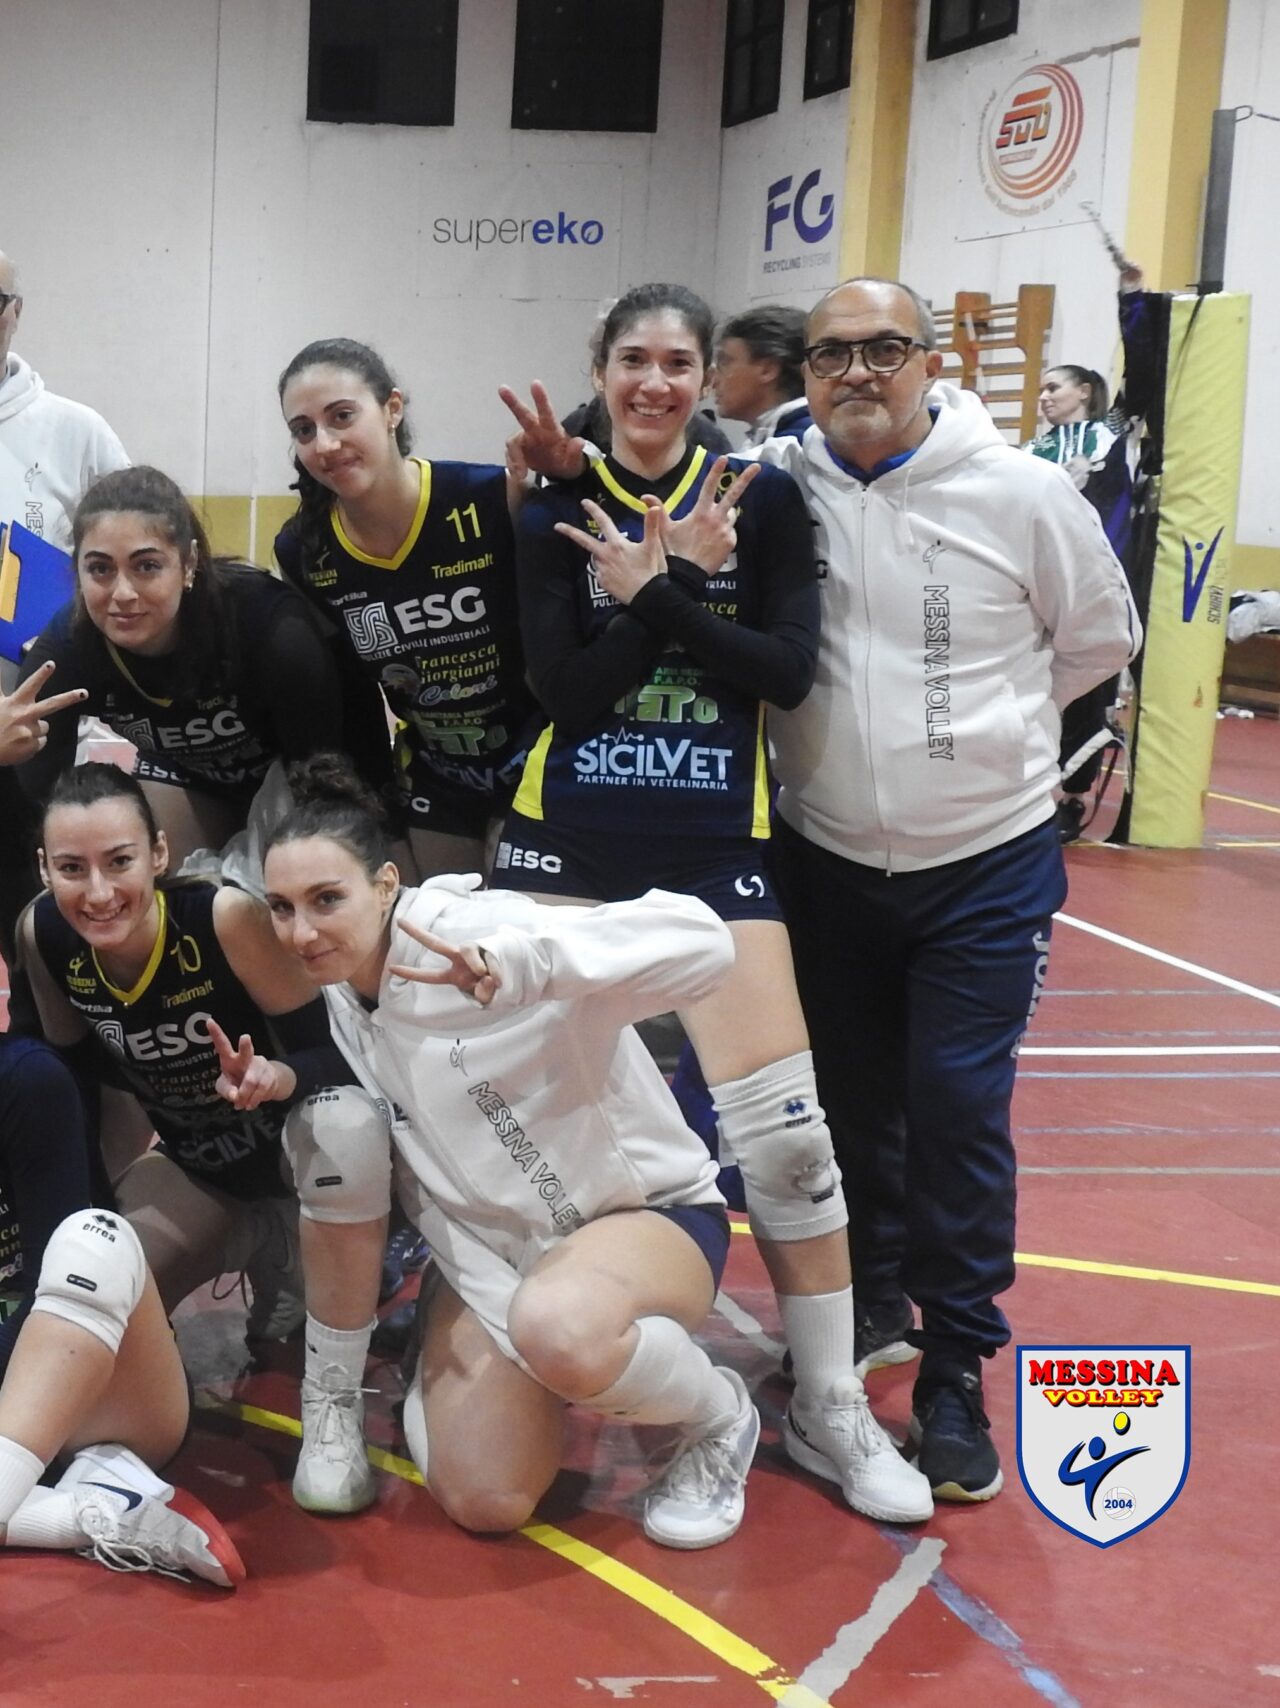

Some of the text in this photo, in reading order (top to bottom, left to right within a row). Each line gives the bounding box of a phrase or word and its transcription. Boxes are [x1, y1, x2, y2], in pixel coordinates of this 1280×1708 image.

[764, 168, 835, 252] FG
[432, 211, 604, 251] supereko
[445, 502, 482, 543] 11
[431, 552, 494, 579] Tradimalt
[393, 586, 487, 634] ESG
[429, 624, 491, 647] INDUSTRIALI
[923, 585, 955, 761] MESSINA VOLLEY
[157, 710, 246, 748] ESG
[574, 738, 732, 780] SICILVET
[577, 774, 729, 791] PARTNER IN VETERINARIA
[511, 847, 562, 874] ESG
[466, 1081, 540, 1174] MESSINA
